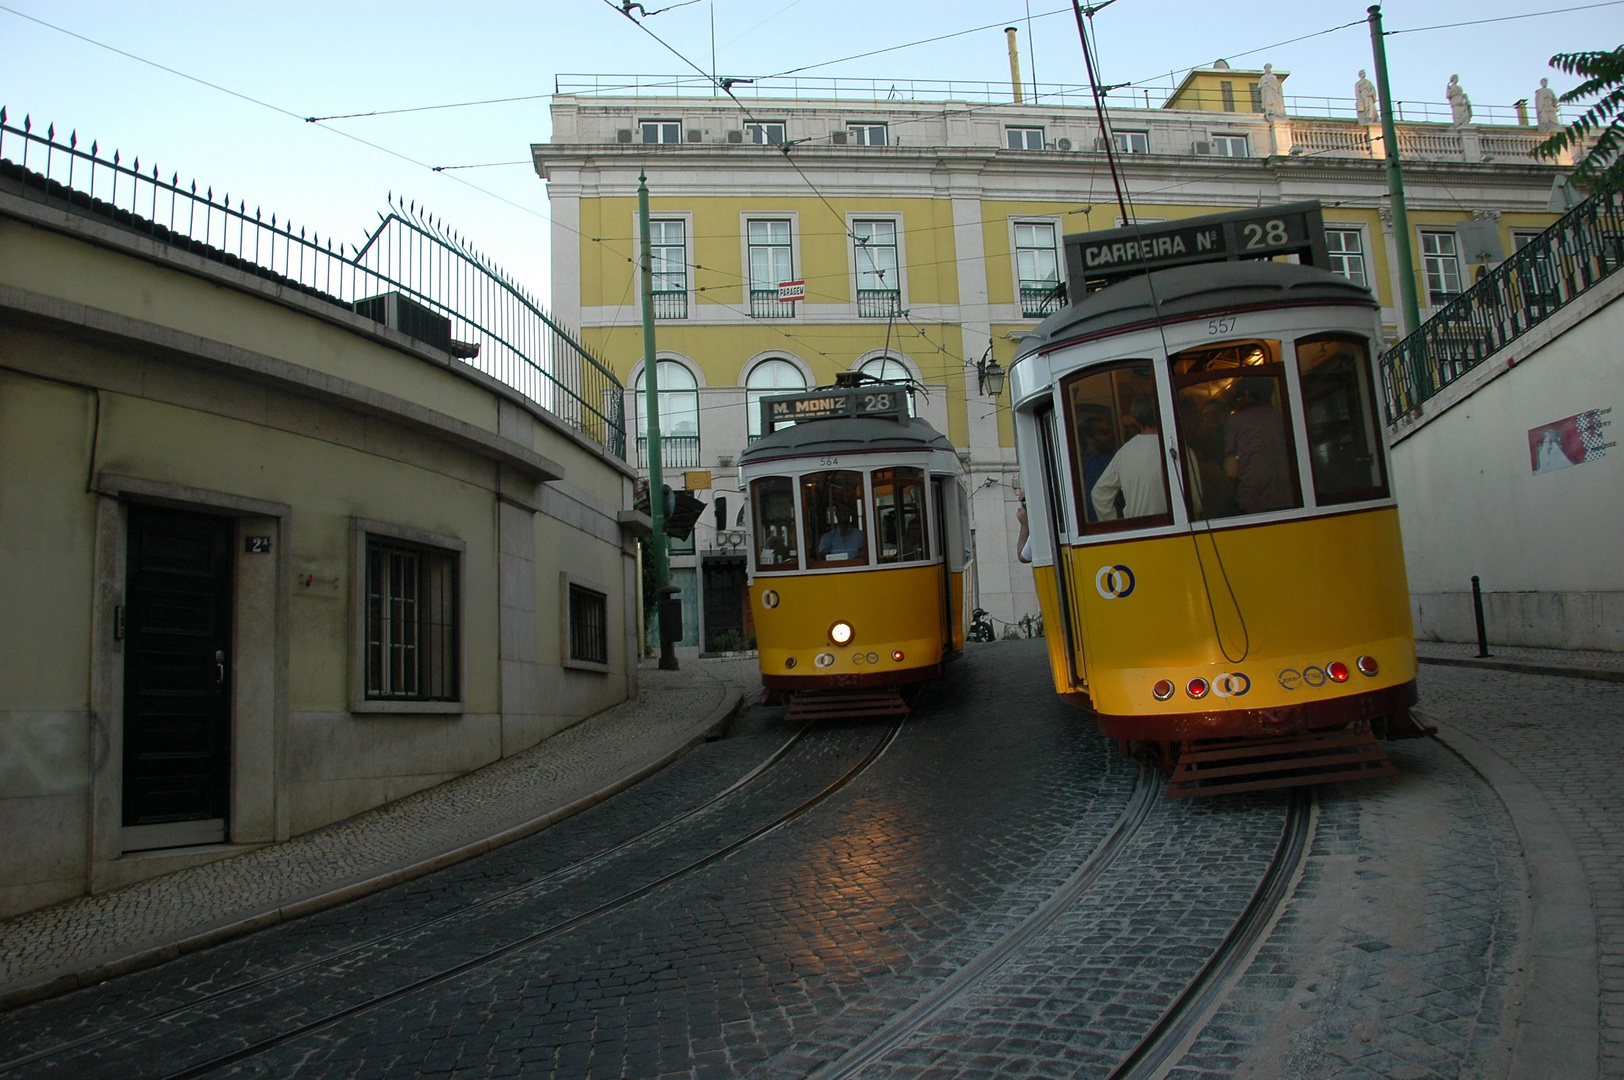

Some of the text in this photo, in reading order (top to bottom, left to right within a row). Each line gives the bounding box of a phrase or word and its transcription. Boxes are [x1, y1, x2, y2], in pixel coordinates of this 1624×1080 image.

[1085, 235, 1186, 267] CARREIRA
[1243, 219, 1289, 250] 28
[780, 286, 804, 297] PARAGEM
[1208, 317, 1237, 335] 557
[773, 394, 891, 414] M. MONIZ 28
[820, 457, 839, 466] 564
